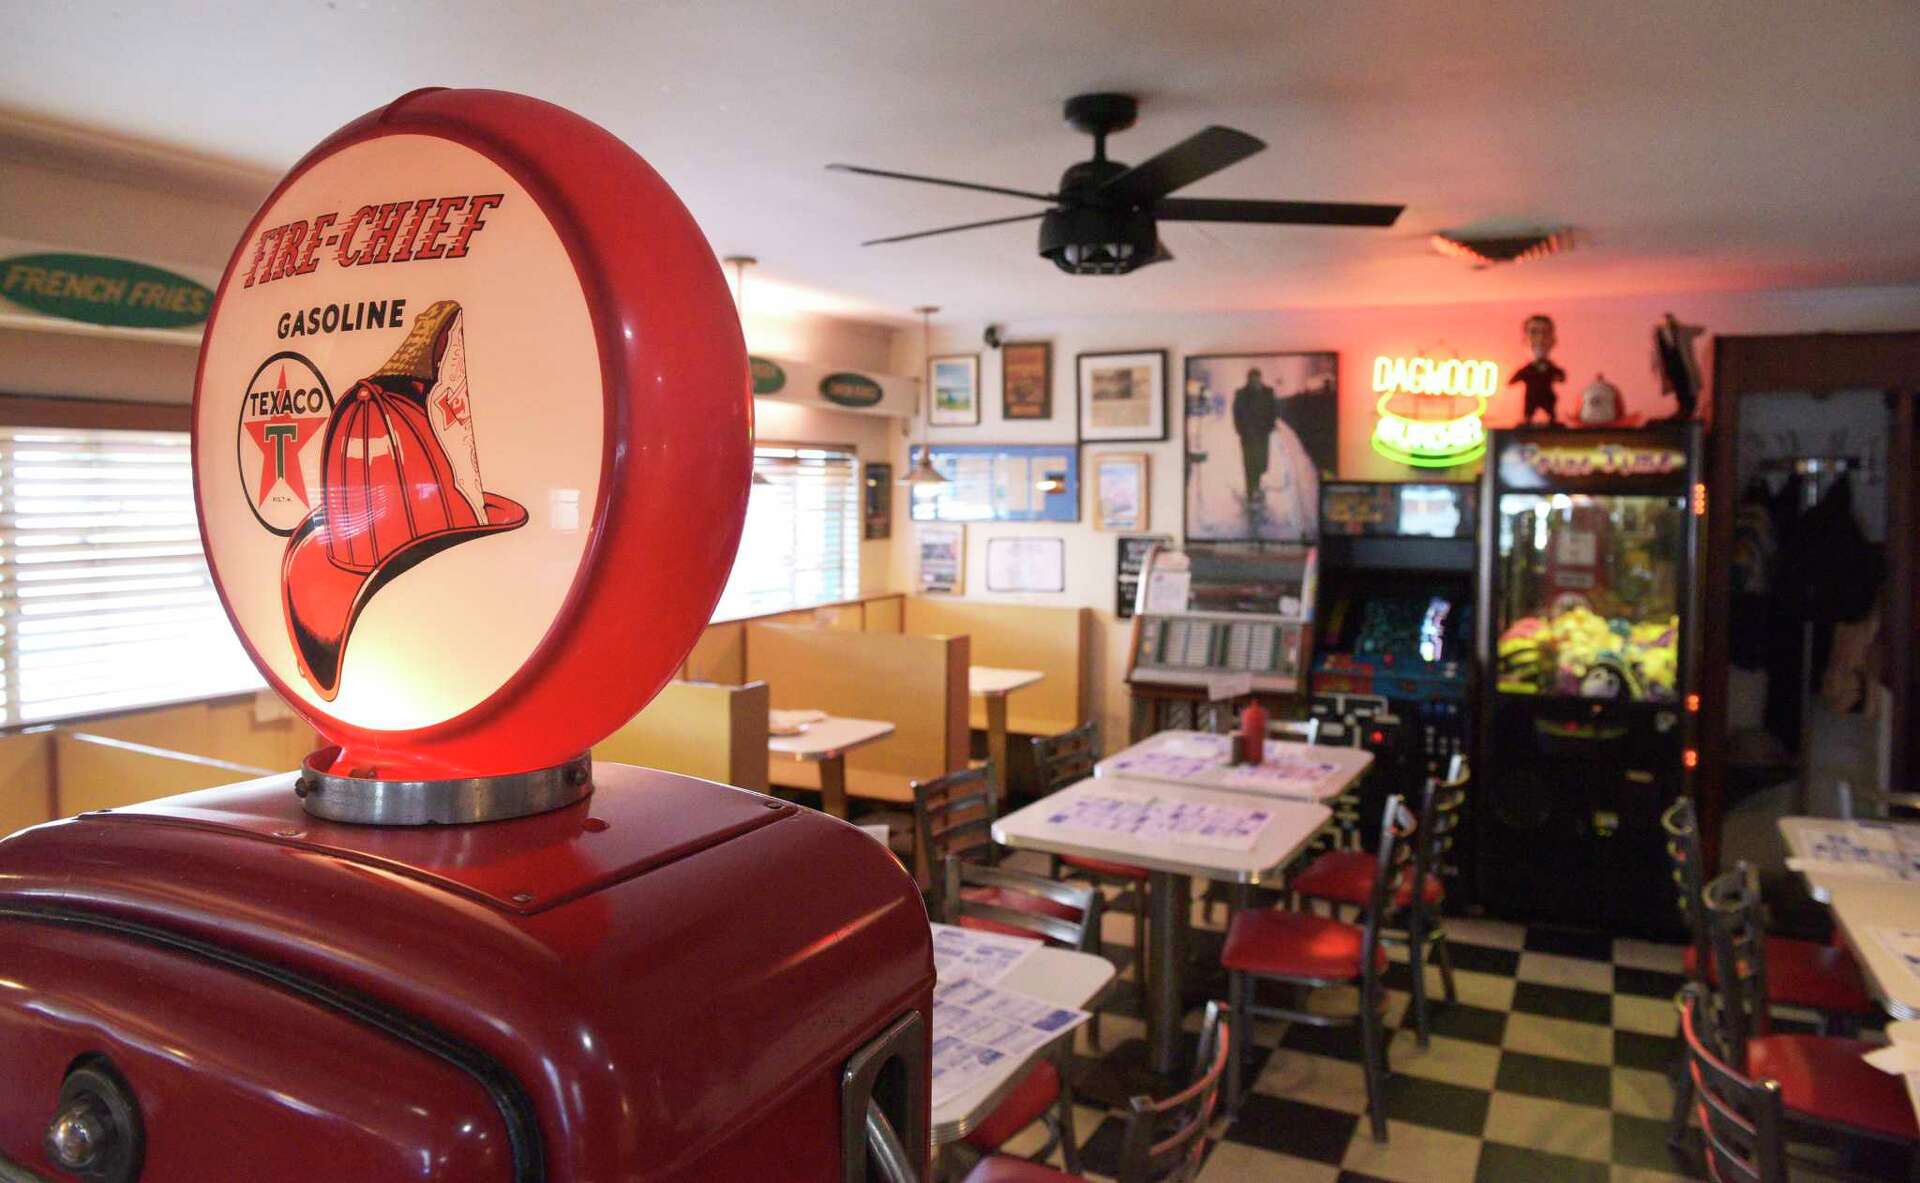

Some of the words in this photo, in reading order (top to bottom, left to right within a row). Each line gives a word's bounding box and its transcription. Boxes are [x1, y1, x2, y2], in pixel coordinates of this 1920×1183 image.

[243, 193, 505, 289] FIRE-CHIEF
[4, 265, 127, 305] FRENCH
[127, 281, 206, 314] FRIES
[277, 299, 406, 340] GASOLINE
[1372, 356, 1498, 396] DAGWOOD
[250, 388, 324, 417] TEXACO
[265, 425, 297, 480] T
